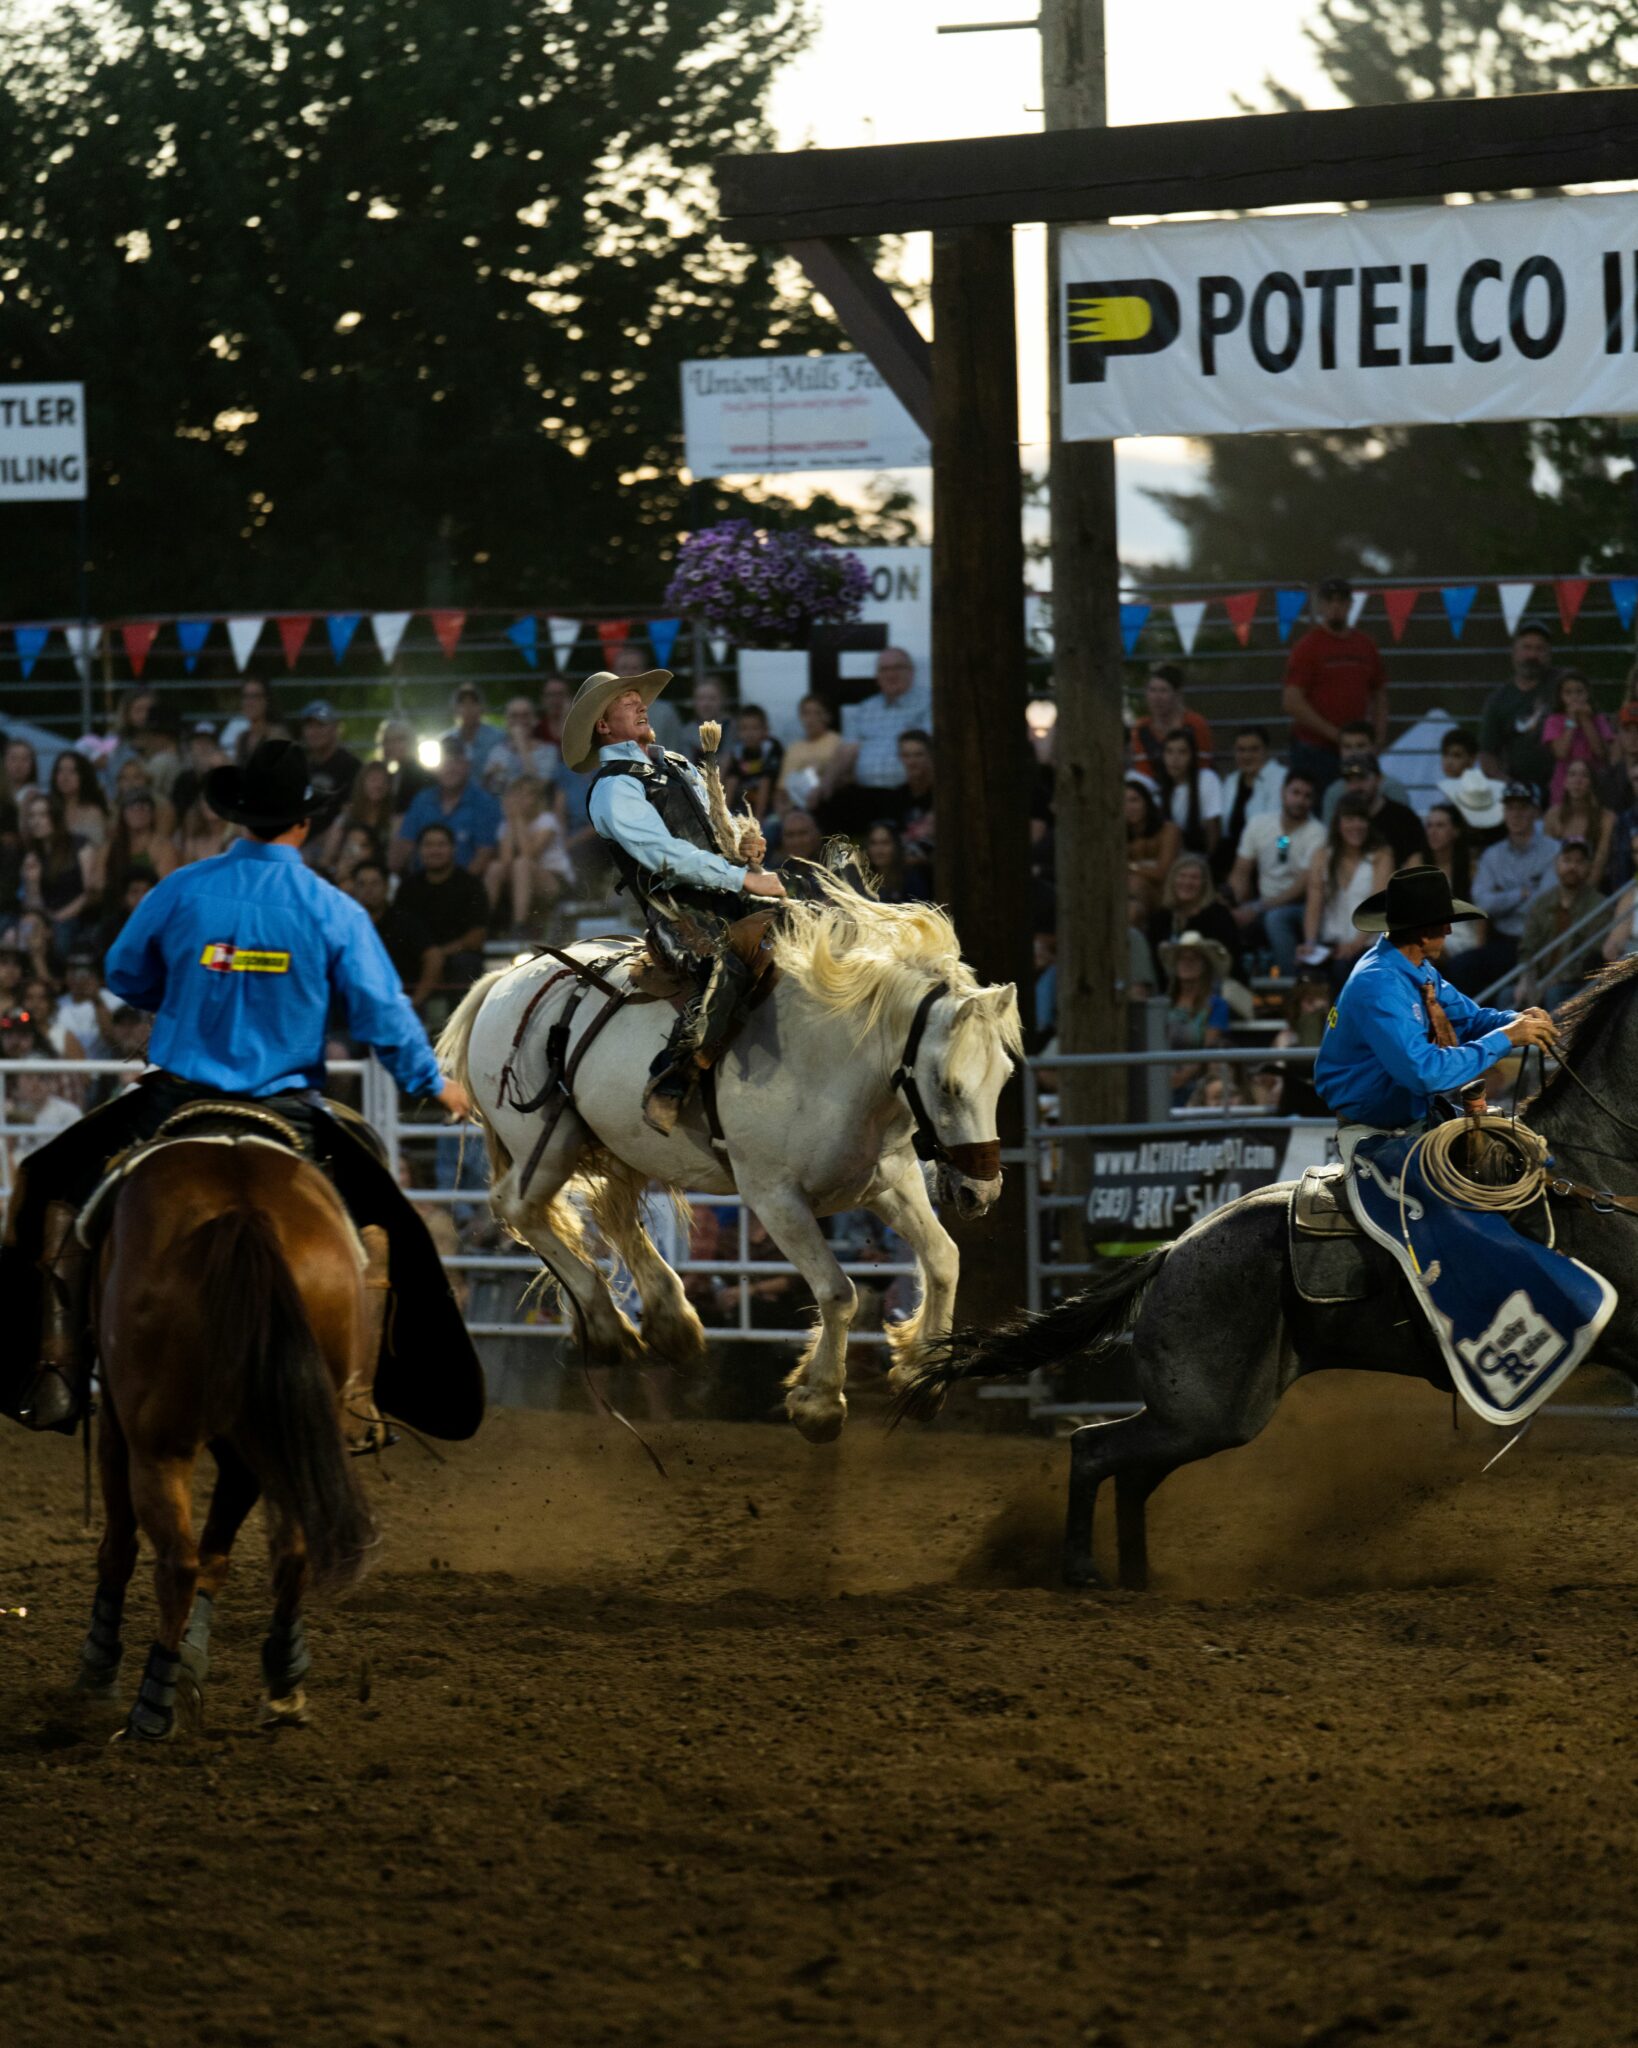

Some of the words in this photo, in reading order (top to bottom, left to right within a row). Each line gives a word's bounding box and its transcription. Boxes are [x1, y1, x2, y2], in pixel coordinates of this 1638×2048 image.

[1199, 255, 1567, 376] POTELCO
[1603, 249, 1638, 355] I
[0, 397, 76, 428] TLER
[0, 455, 80, 484] ILING
